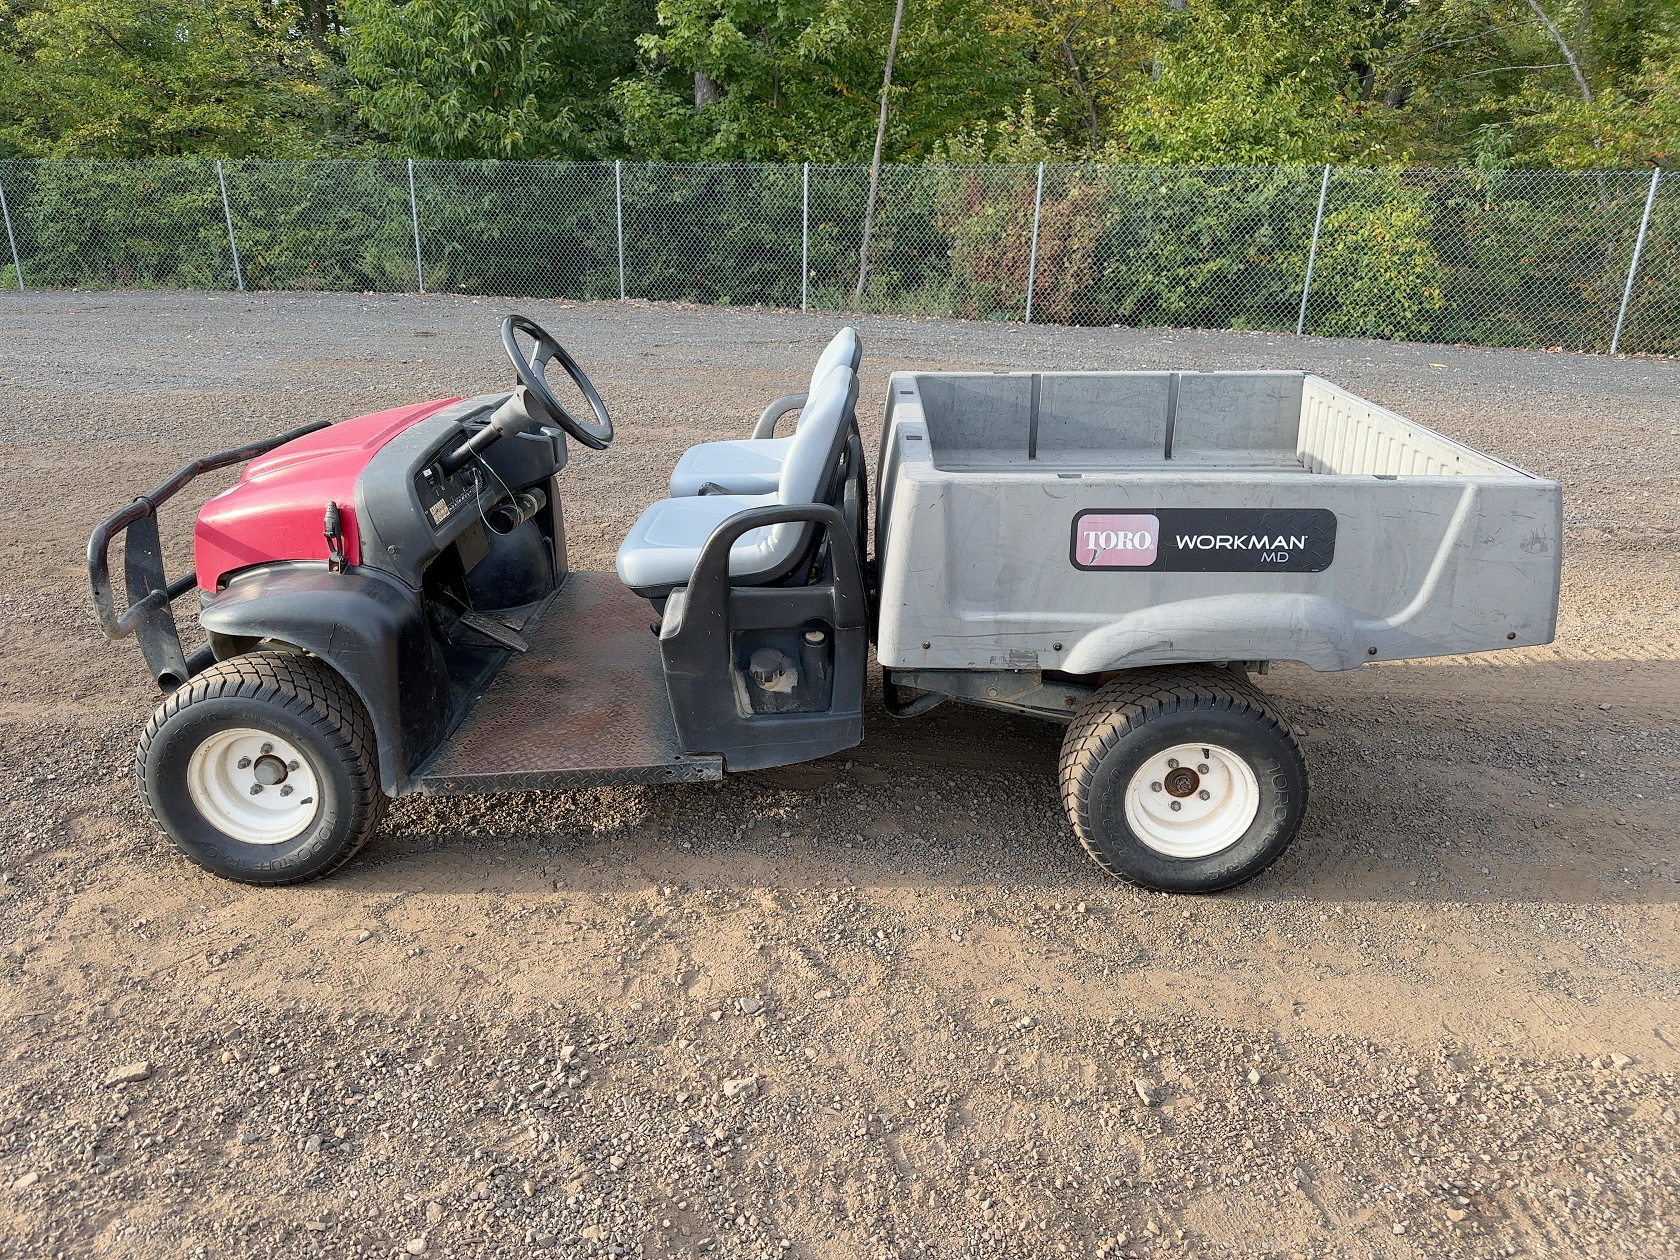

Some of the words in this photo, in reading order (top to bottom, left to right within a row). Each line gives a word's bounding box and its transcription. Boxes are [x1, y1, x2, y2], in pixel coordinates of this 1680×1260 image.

[1084, 531, 1151, 550] TORO
[1176, 535, 1306, 550] WORKMAN
[1261, 552, 1289, 563] MD
[1268, 761, 1291, 821] TORO
[297, 818, 338, 862] TORO
